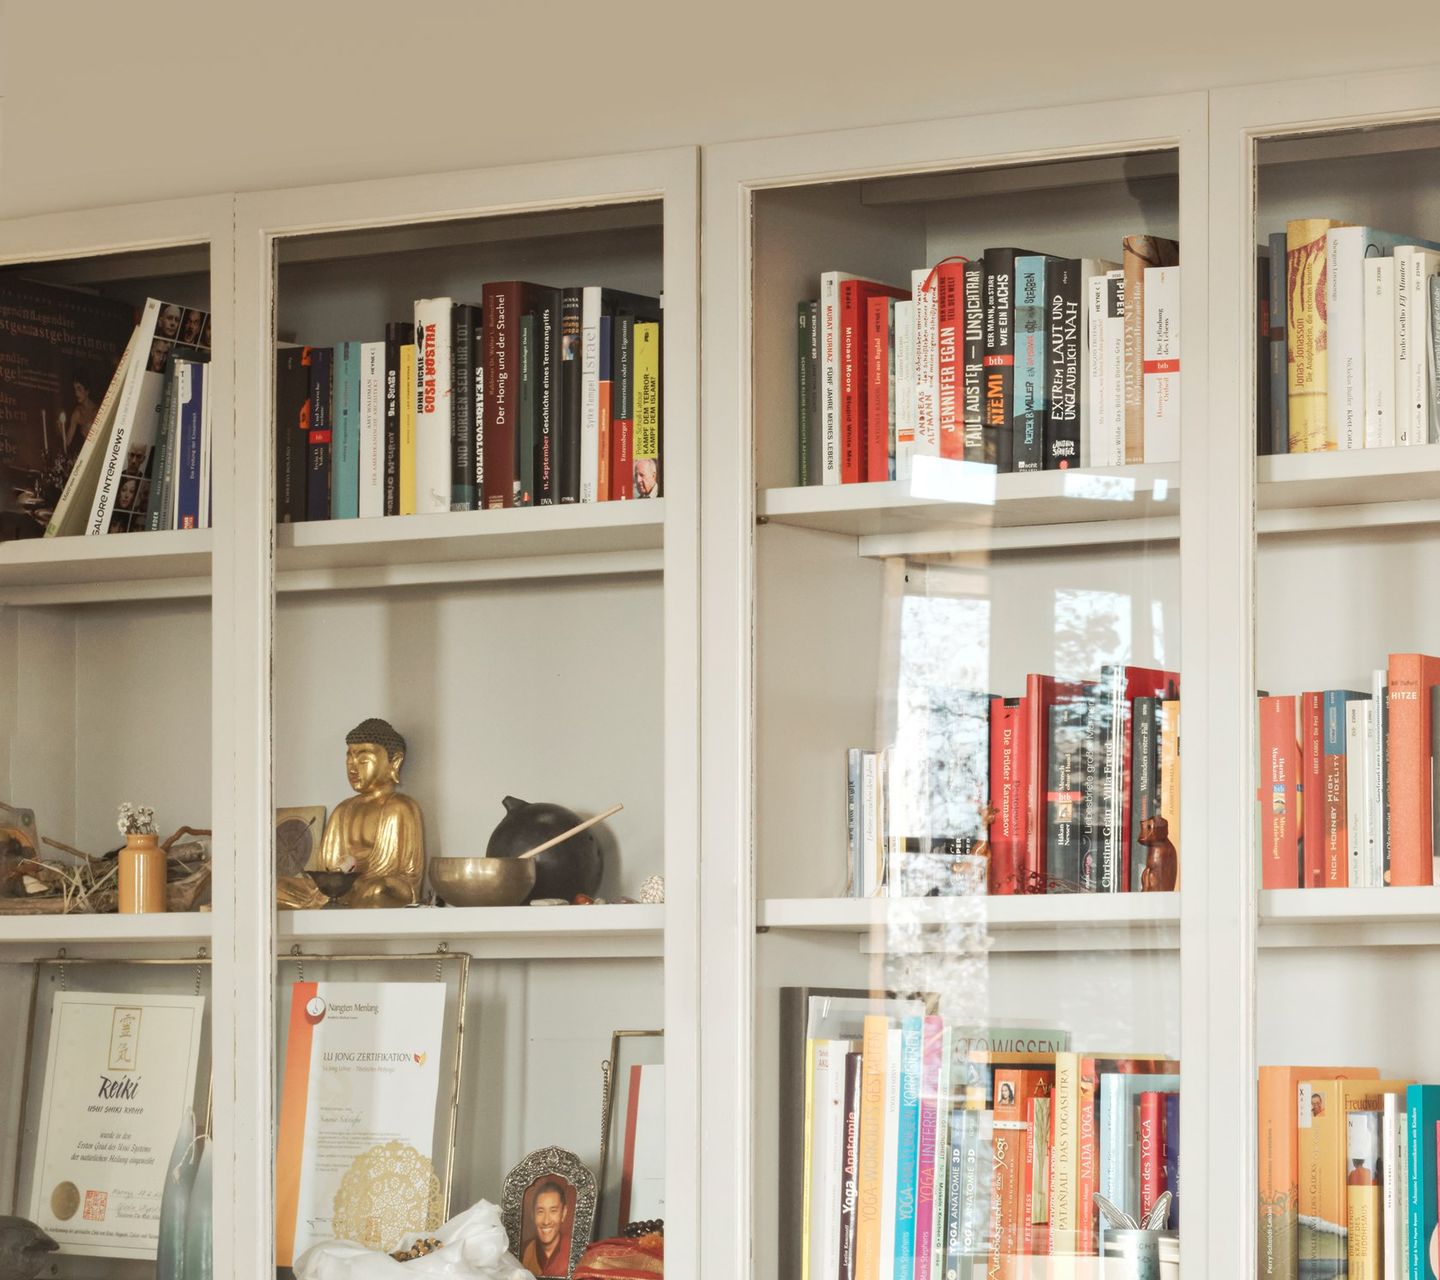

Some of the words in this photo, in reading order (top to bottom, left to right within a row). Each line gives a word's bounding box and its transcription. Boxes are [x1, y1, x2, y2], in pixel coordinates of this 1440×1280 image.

[997, 274, 1008, 309] LACHS
[1052, 295, 1062, 320] UND
[497, 294, 505, 329] Stachel
[998, 312, 1007, 325] EIN
[1065, 302, 1077, 340] NAH
[497, 332, 505, 347] der
[941, 327, 955, 361] EGAN
[998, 328, 1008, 346] WIE
[1052, 324, 1064, 364] LAUT
[1295, 318, 1304, 358] Jonasson
[497, 373, 507, 403] Honig
[965, 364, 982, 412] AUSTER
[1065, 344, 1076, 420] UNGLAUBLICH
[1295, 362, 1304, 387] Jonas
[425, 379, 436, 413] COSA
[941, 367, 955, 432] JENNIFER
[497, 406, 505, 424] Der
[966, 417, 982, 447] PAUL
[1105, 743, 1113, 773] Freud
[1103, 777, 1112, 800] Villa
[1102, 809, 1112, 836] Grän
[1102, 838, 1112, 887] Christine
[357, 1053, 411, 1062] ZERTIFIKATION
[1082, 1106, 1092, 1139] YOGA
[952, 1149, 960, 1163] 3D
[1082, 1143, 1092, 1178] NADA
[950, 1166, 959, 1218] ANATOMIE
[950, 1222, 958, 1253] YOGA
